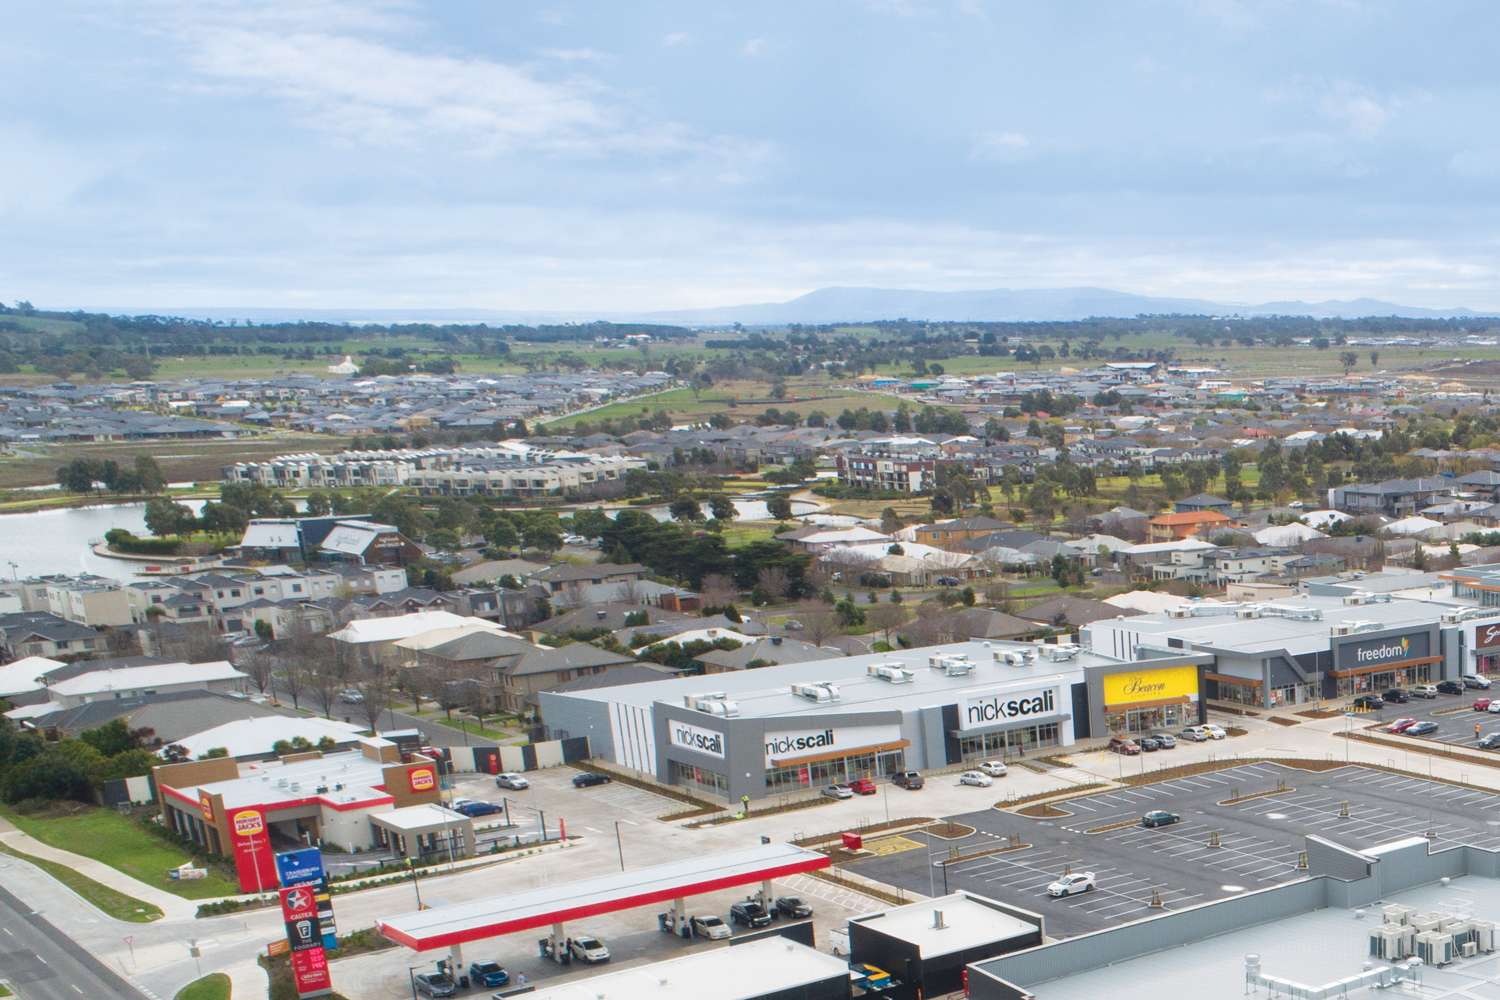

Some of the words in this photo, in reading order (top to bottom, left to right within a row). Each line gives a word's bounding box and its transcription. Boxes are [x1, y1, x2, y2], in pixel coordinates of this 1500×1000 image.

[1357, 644, 1403, 662] freedom
[1123, 676, 1166, 695] Beacon
[969, 690, 1054, 724] nickscali
[676, 726, 722, 754] nickscali
[765, 729, 834, 755] nickscali
[291, 911, 314, 920] CALTEX
